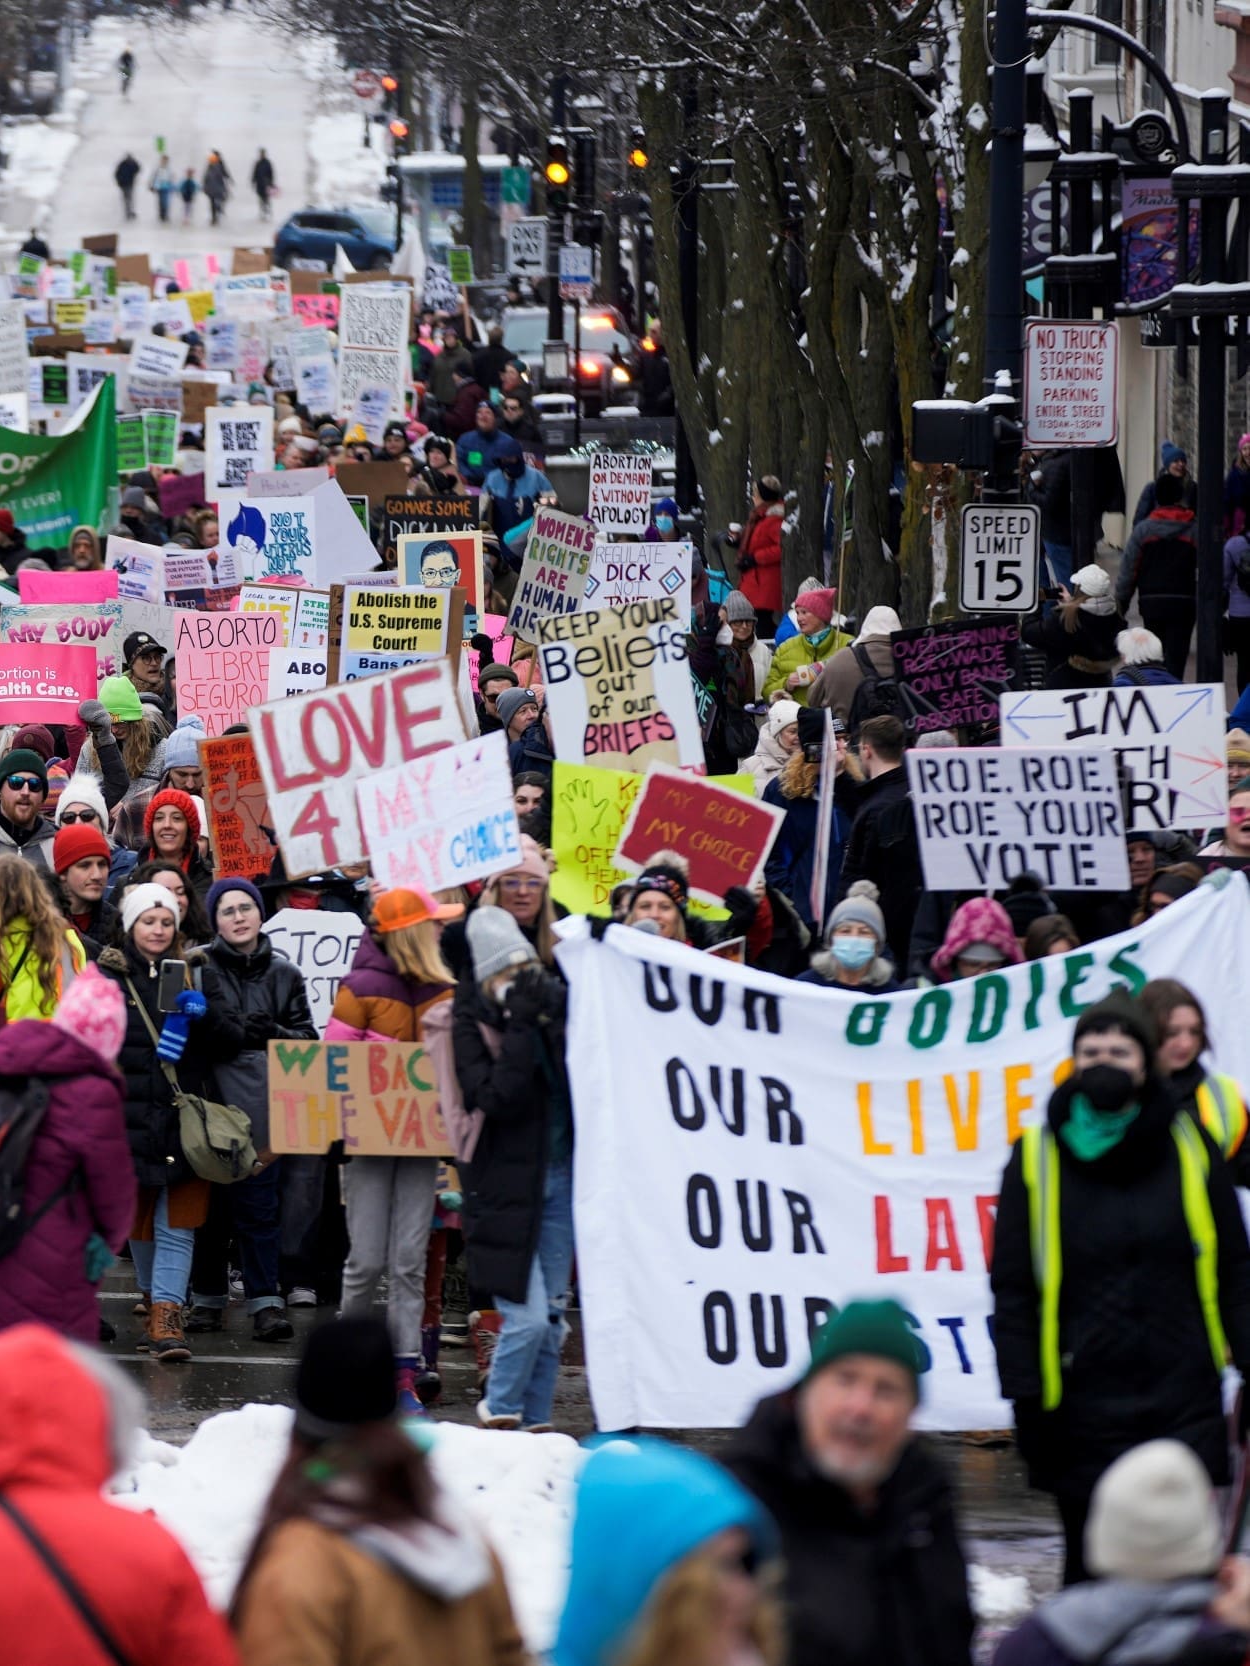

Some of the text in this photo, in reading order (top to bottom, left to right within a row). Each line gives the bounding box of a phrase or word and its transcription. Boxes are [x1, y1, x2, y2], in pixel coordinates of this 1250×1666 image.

[512, 226, 542, 239] ONE
[512, 241, 542, 255] WAY
[1036, 329, 1107, 350] NO TRUCK
[1039, 351, 1104, 366] STOPPING
[1039, 366, 1103, 382] STANDING
[1043, 388, 1098, 402] PARKING
[1035, 405, 1105, 417] ENTIRE STREET
[593, 454, 651, 469] ABORTION
[593, 472, 651, 485] ON DEMAND
[602, 489, 650, 504] WITHOUT
[386, 499, 472, 516] GO MAKE SOME
[591, 506, 650, 525] APOLOGY
[270, 512, 305, 527] NOT
[970, 515, 1030, 535] SPEED
[270, 528, 311, 546] YOUR
[390, 520, 430, 541] DICK
[536, 514, 596, 551] WOMEN'S
[263, 544, 312, 557] UTERUS
[529, 537, 590, 574] RIGHTS
[595, 544, 666, 565] REGULATE
[975, 537, 1025, 555] LIMIT
[267, 557, 297, 571] NOT
[606, 563, 652, 582] DICK
[535, 566, 568, 591] ARE
[614, 581, 643, 595] NOT
[974, 560, 1023, 602] 15
[357, 592, 437, 609] Abolish the
[521, 583, 578, 613] HUMAN
[55, 616, 117, 642] BODY
[350, 613, 442, 631] U.S. Supreme
[538, 597, 679, 645] KEEP YOUR
[176, 617, 276, 650] ABORTO
[372, 635, 417, 651] Court!
[893, 624, 1019, 659] OVERTURNING
[358, 658, 399, 669] Bans
[543, 623, 687, 684] Beliefs
[903, 644, 1006, 676] ROE WADE
[44, 666, 56, 680] is
[188, 651, 270, 682] LIBRE
[596, 673, 637, 694] out
[912, 664, 1007, 695] ONLY BANS
[35, 683, 80, 698] Care.
[179, 683, 263, 712] SEGURO
[939, 687, 984, 709] SAFE
[589, 694, 656, 719] of our
[261, 667, 452, 793] LOVE
[583, 712, 676, 756] BRIEFS
[208, 742, 246, 756] BANS OFF
[209, 758, 230, 771] BANS
[373, 761, 436, 838] MY
[663, 787, 752, 828] MY BODY
[290, 791, 341, 867] 4
[923, 799, 1122, 839] ROE YOUR
[387, 811, 518, 890] MY CHOICE
[645, 817, 756, 872] MY CHOICE
[222, 857, 260, 873] BANS OFF
[963, 842, 1099, 887] VOTE
[642, 942, 1148, 1050] OUR BODIES
[274, 1042, 350, 1093] WE
[665, 1057, 1074, 1156] OUR LIVE
[273, 1090, 359, 1149] THE
[686, 1172, 827, 1255] OUR
